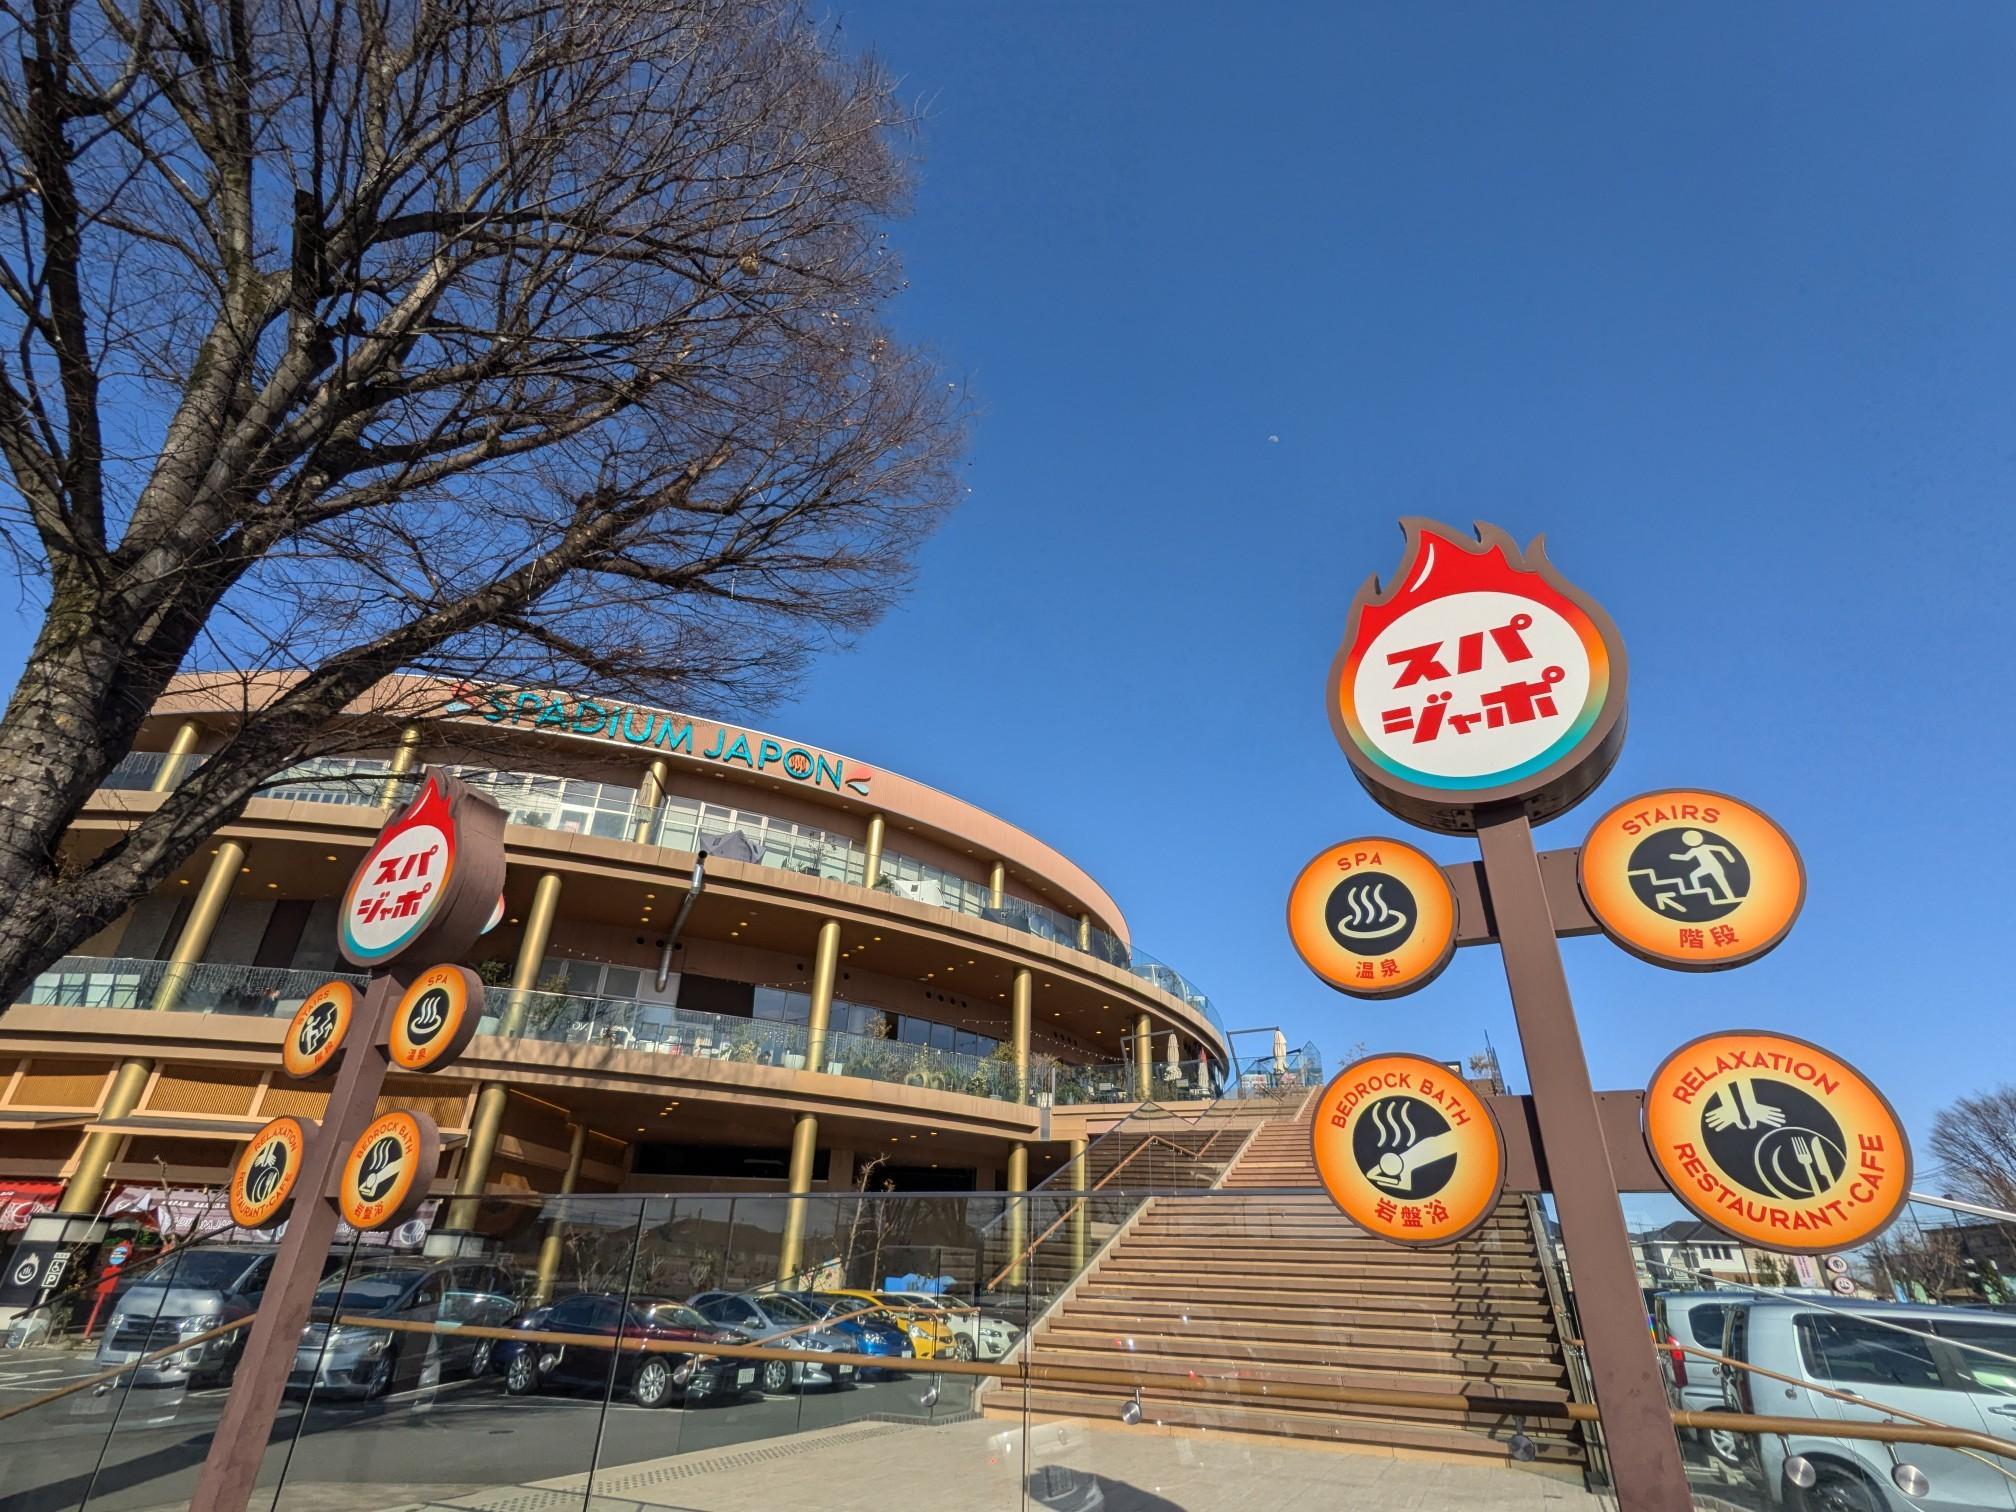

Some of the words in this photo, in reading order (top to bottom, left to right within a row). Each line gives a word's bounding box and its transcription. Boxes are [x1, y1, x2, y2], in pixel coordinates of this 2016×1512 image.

[1386, 613, 1534, 690] スパ
[1381, 665, 1566, 745] ジャポ
[483, 690, 693, 754] SPADIUM
[703, 728, 843, 790] JAPON
[1621, 804, 1721, 836] STAIRS
[373, 844, 439, 886] スパ
[1337, 852, 1382, 871] SPA
[356, 882, 433, 924] ジャポ
[1679, 924, 1740, 949] 階段
[427, 974, 449, 986] SPA
[1355, 959, 1401, 980] 温泉
[1672, 1050, 1841, 1105] RELAXATION
[1331, 1072, 1412, 1129] BEDROCK
[1419, 1078, 1472, 1127] BATH
[356, 1122, 400, 1159] BEDROCK
[399, 1125, 415, 1155] BATH
[1374, 1197, 1450, 1228] 岩盤浴
[45, 1274, 57, 1285] P
